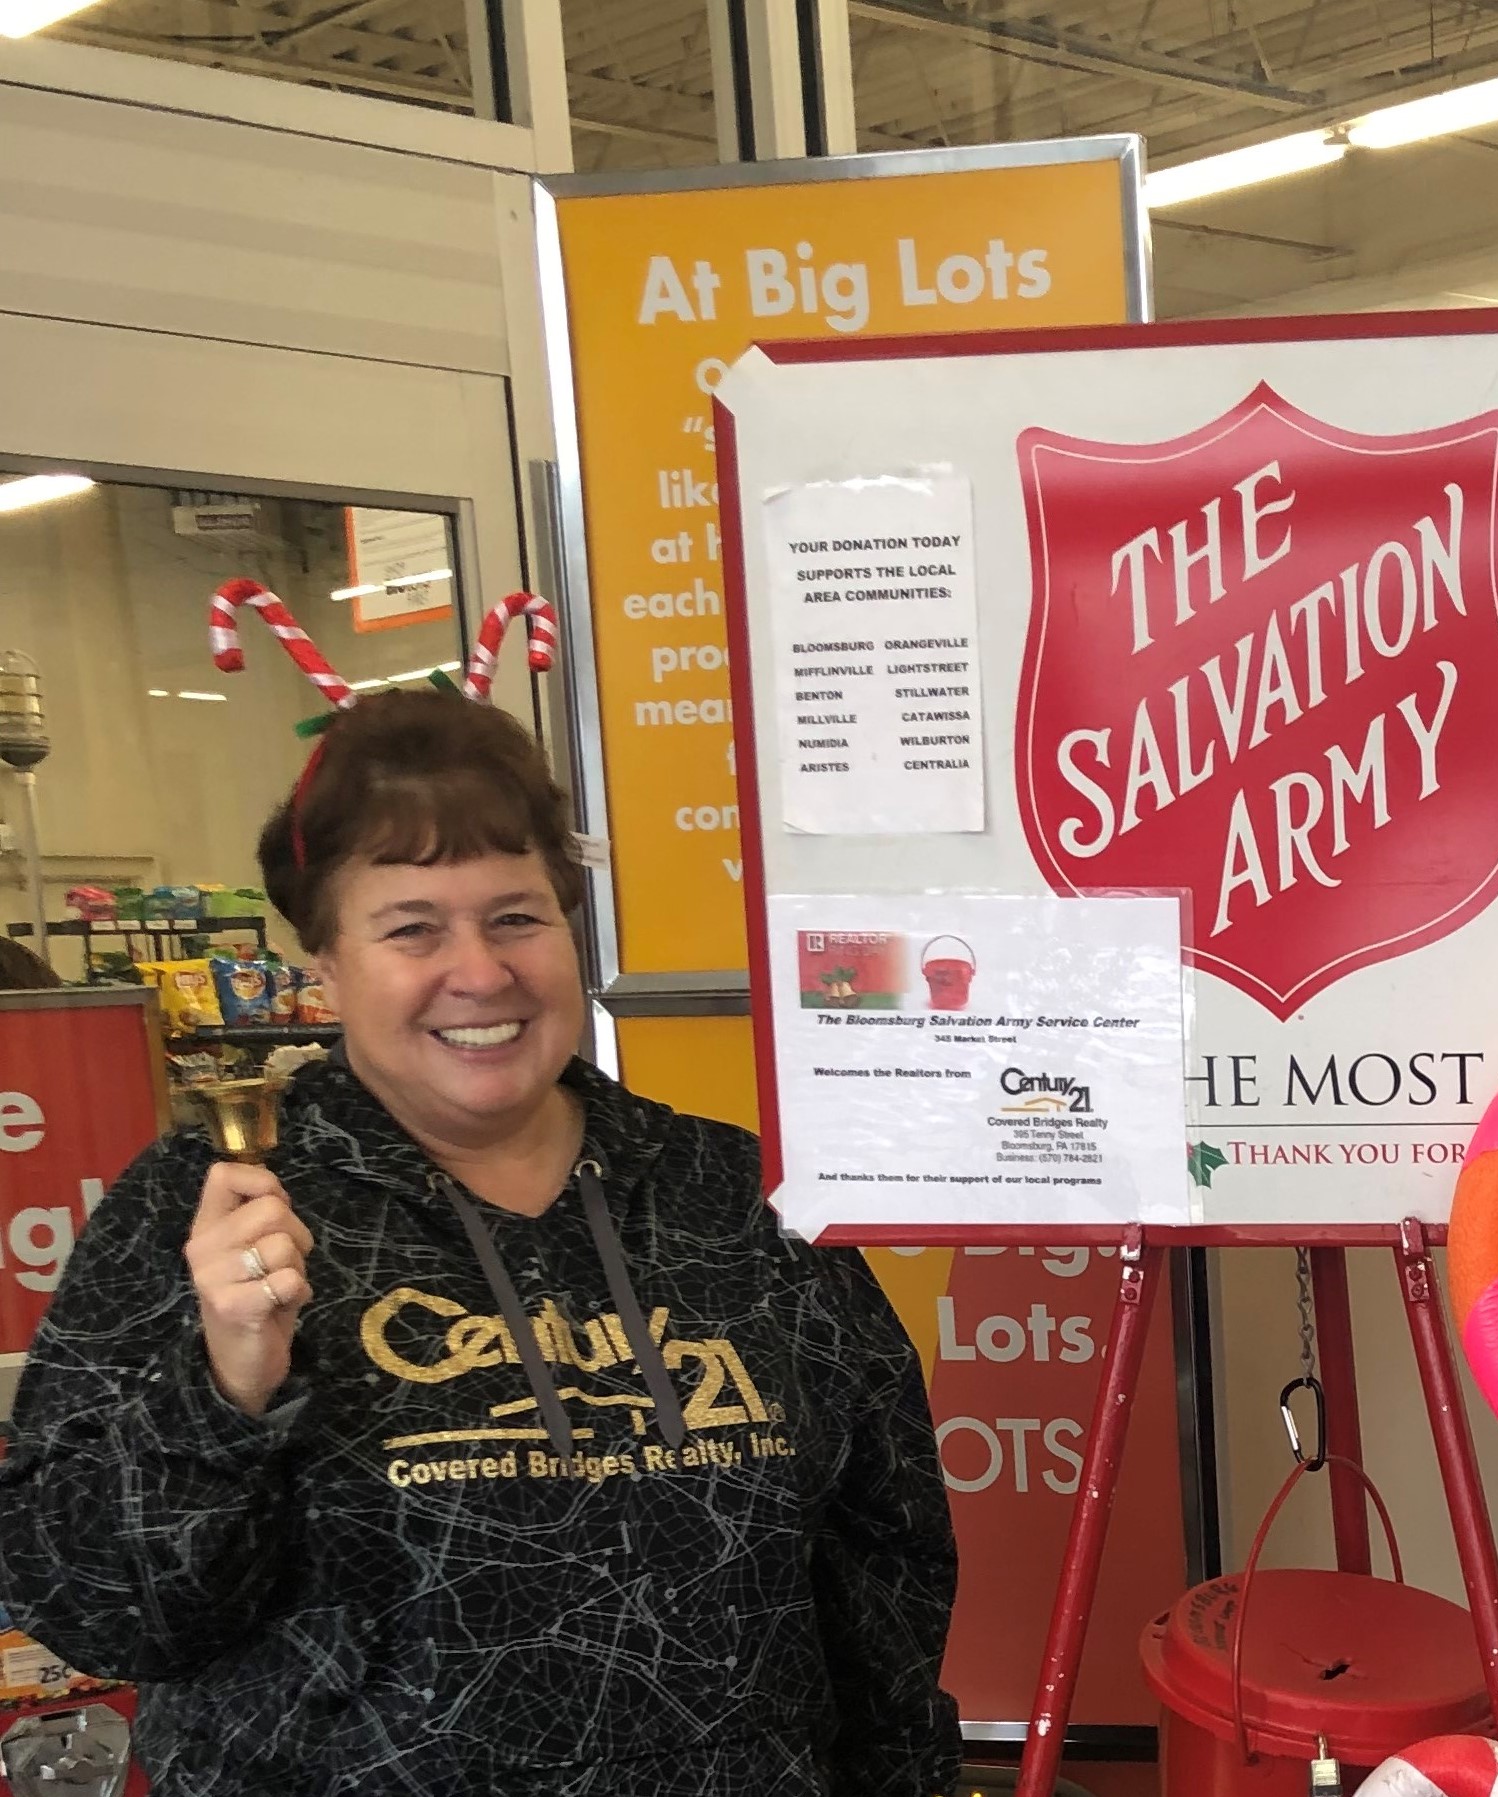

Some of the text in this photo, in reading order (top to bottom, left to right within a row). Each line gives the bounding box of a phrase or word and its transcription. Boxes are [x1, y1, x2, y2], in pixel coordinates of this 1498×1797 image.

[637, 236, 1052, 333] At Big Lots
[651, 531, 693, 564] at
[789, 535, 961, 554] YOUR DONATION TODAY
[1110, 460, 1296, 655] THE
[797, 564, 957, 582] SUPPORTS THE LOCAL
[623, 577, 721, 619] each
[804, 587, 952, 603] AREA COMMUNITIES:
[792, 641, 875, 653] BLOOMSBURG
[884, 637, 969, 650] ORANGEVILLE
[652, 645, 729, 683] pro
[794, 665, 874, 677] MIFFLINVILLE
[887, 662, 969, 674] LIGHTSTREET
[1057, 482, 1467, 858] SALVATION
[796, 690, 843, 701] BENTON
[895, 686, 969, 698] STILLWATER
[797, 714, 858, 725] MILLVILLE
[902, 710, 971, 722] CATAWISSA
[798, 738, 849, 749] NUMIDIA
[900, 735, 970, 746] WILBURTON
[800, 762, 850, 773] ARISTES
[904, 759, 970, 770] CENTRALIA
[1209, 660, 1459, 937] ARMY
[817, 1015, 1140, 1029] The Bloomsburg Salvation Army Service Center
[814, 1067, 972, 1079] Welcomes the Realtors from
[1184, 1053, 1260, 1108] HE
[1283, 1051, 1484, 1108] MOST
[1000, 1067, 1076, 1096] Century
[1068, 1086, 1092, 1113] 21
[987, 1117, 1109, 1130] Covered Bridges Realty
[1227, 1141, 1333, 1165] THANK
[1339, 1143, 1400, 1165] YOU
[818, 1172, 1103, 1186] And thanks them for their support of our local programs
[662, 1338, 769, 1431] 21
[387, 1450, 517, 1487] Covered
[751, 1431, 797, 1460] Inc.
